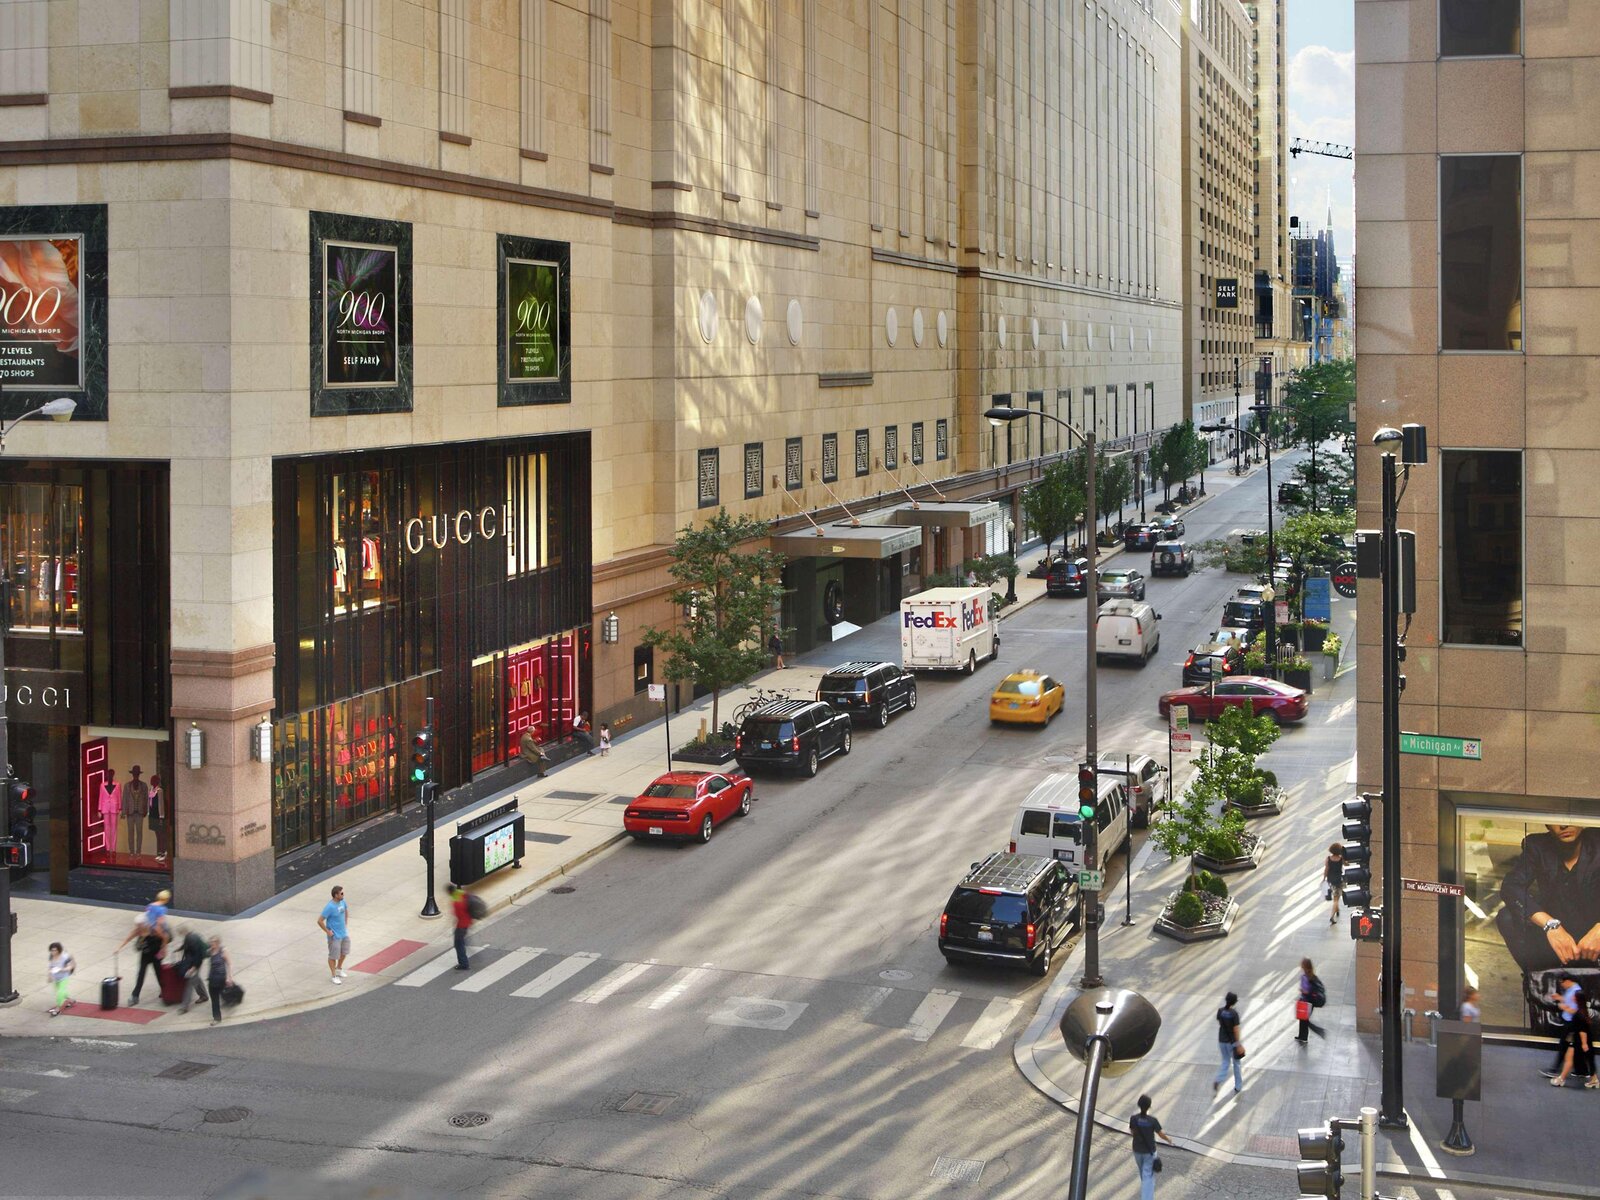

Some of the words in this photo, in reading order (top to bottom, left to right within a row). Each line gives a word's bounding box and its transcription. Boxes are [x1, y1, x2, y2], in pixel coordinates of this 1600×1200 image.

[0, 286, 61, 326] 00
[336, 290, 385, 328] 900
[515, 300, 551, 333] 900
[1, 347, 6, 355] 7
[7, 347, 33, 355] LEVELS
[0, 358, 45, 366] ESTAURANTS
[343, 356, 358, 365] SELF
[360, 356, 376, 365] PARK
[0, 369, 10, 377] 70
[11, 369, 35, 377] SHOPS
[405, 504, 507, 554] GUCCI
[904, 611, 958, 628] FedEx
[962, 598, 984, 632] FedEx
[1409, 737, 1452, 754] Michigan
[1453, 743, 1461, 751] Av
[1406, 882, 1416, 890] THE
[1417, 884, 1448, 894] MAGNIFICENT
[1449, 887, 1462, 896] MILE
